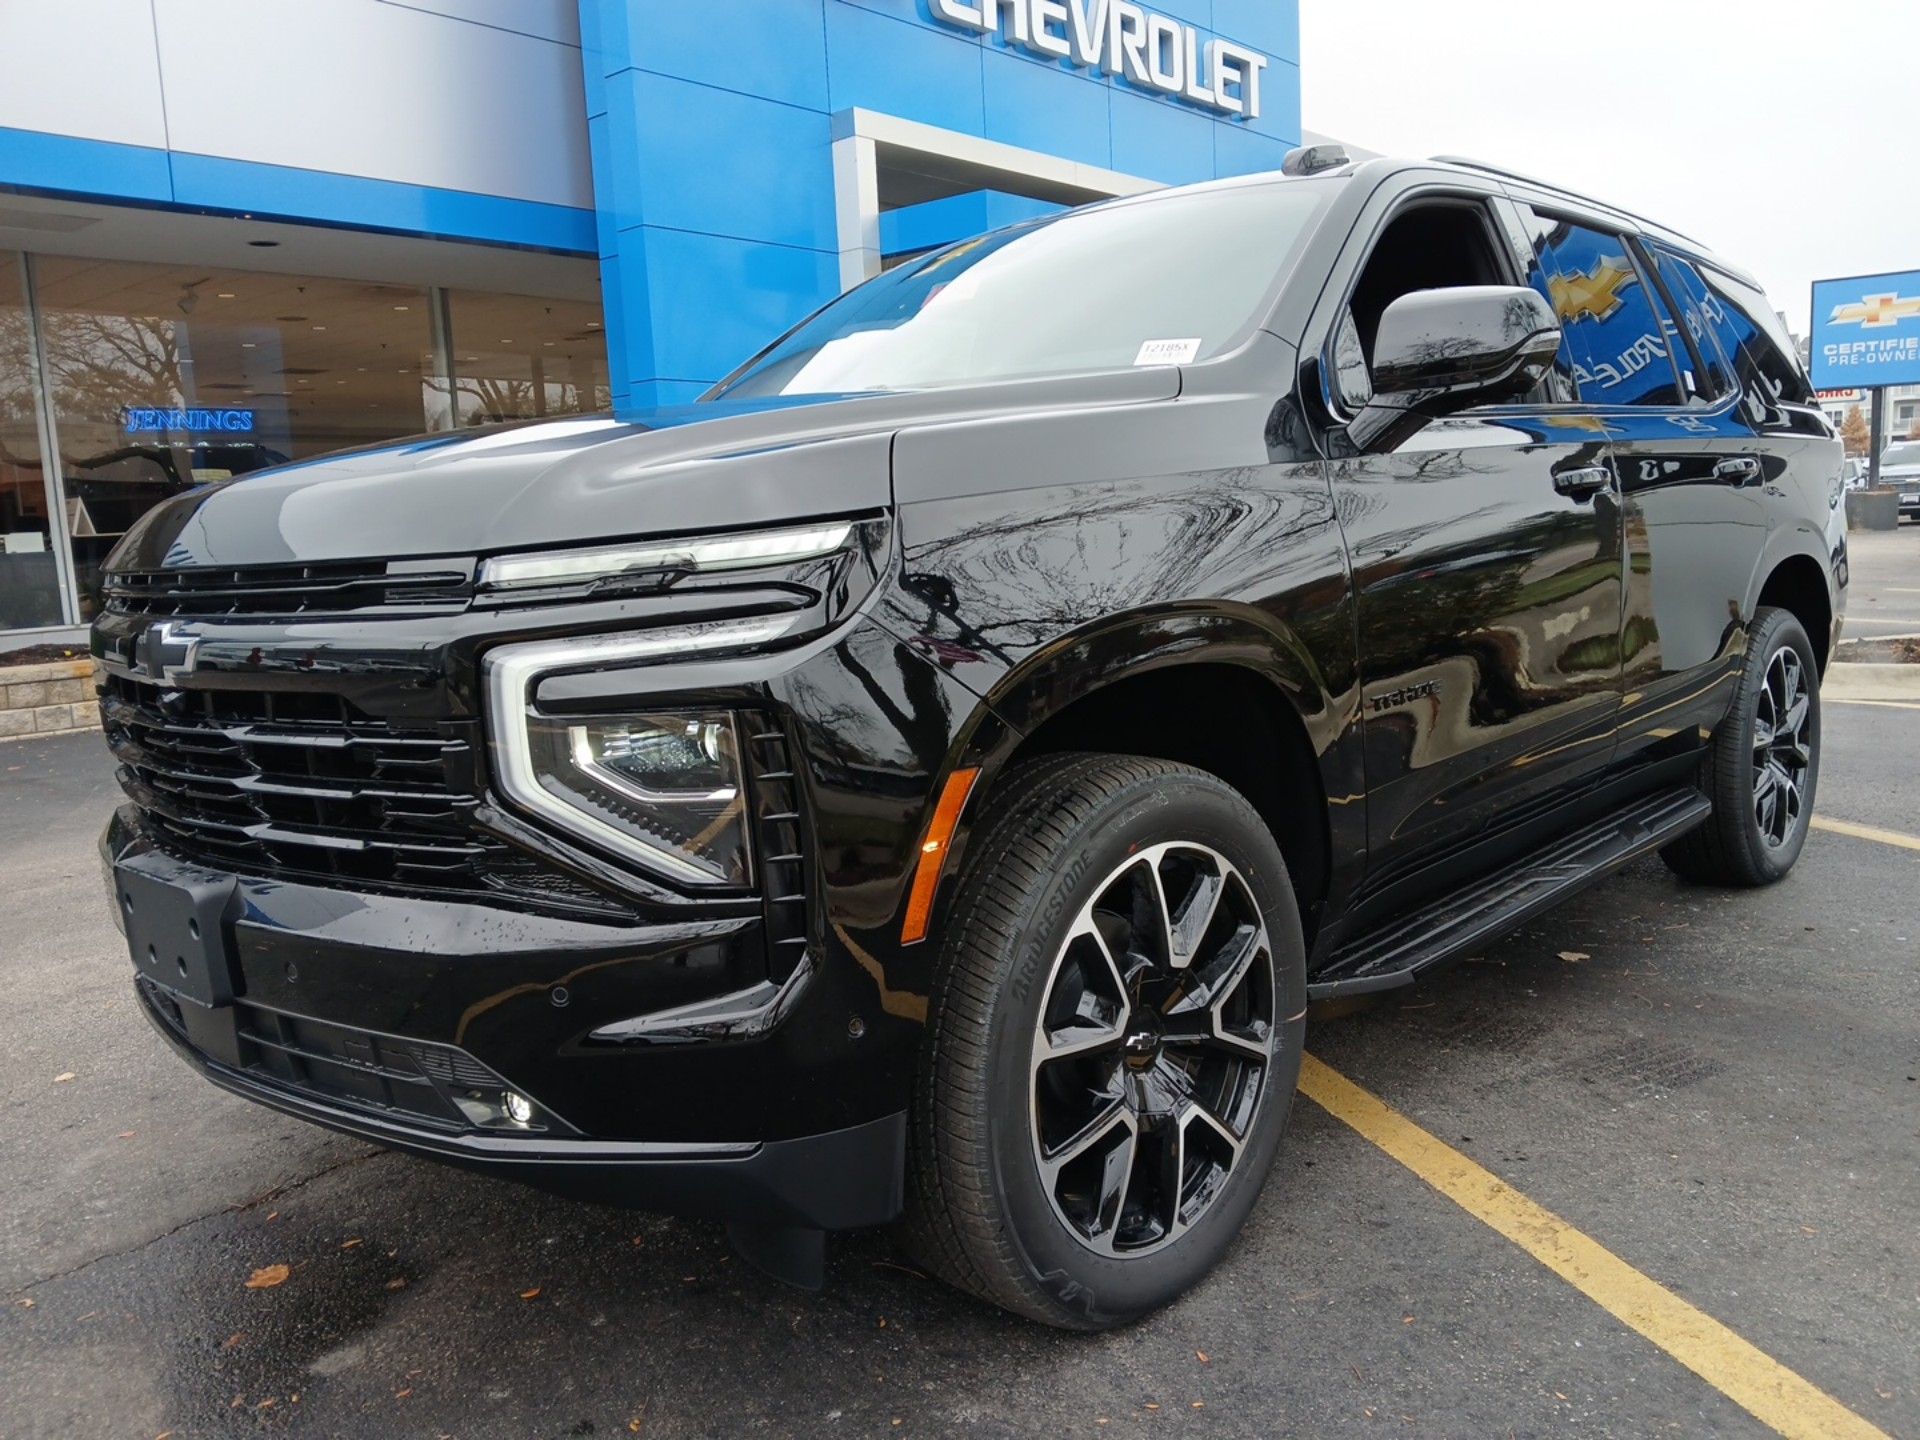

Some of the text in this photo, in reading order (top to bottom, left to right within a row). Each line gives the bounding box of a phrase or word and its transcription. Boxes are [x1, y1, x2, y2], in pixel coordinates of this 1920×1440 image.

[1828, 349, 1920, 367] PRE-OWNE
[126, 409, 254, 433] JENNINGS
[1370, 679, 1442, 712] TAHOE
[1010, 849, 1093, 1006] BRIDGESTONE
